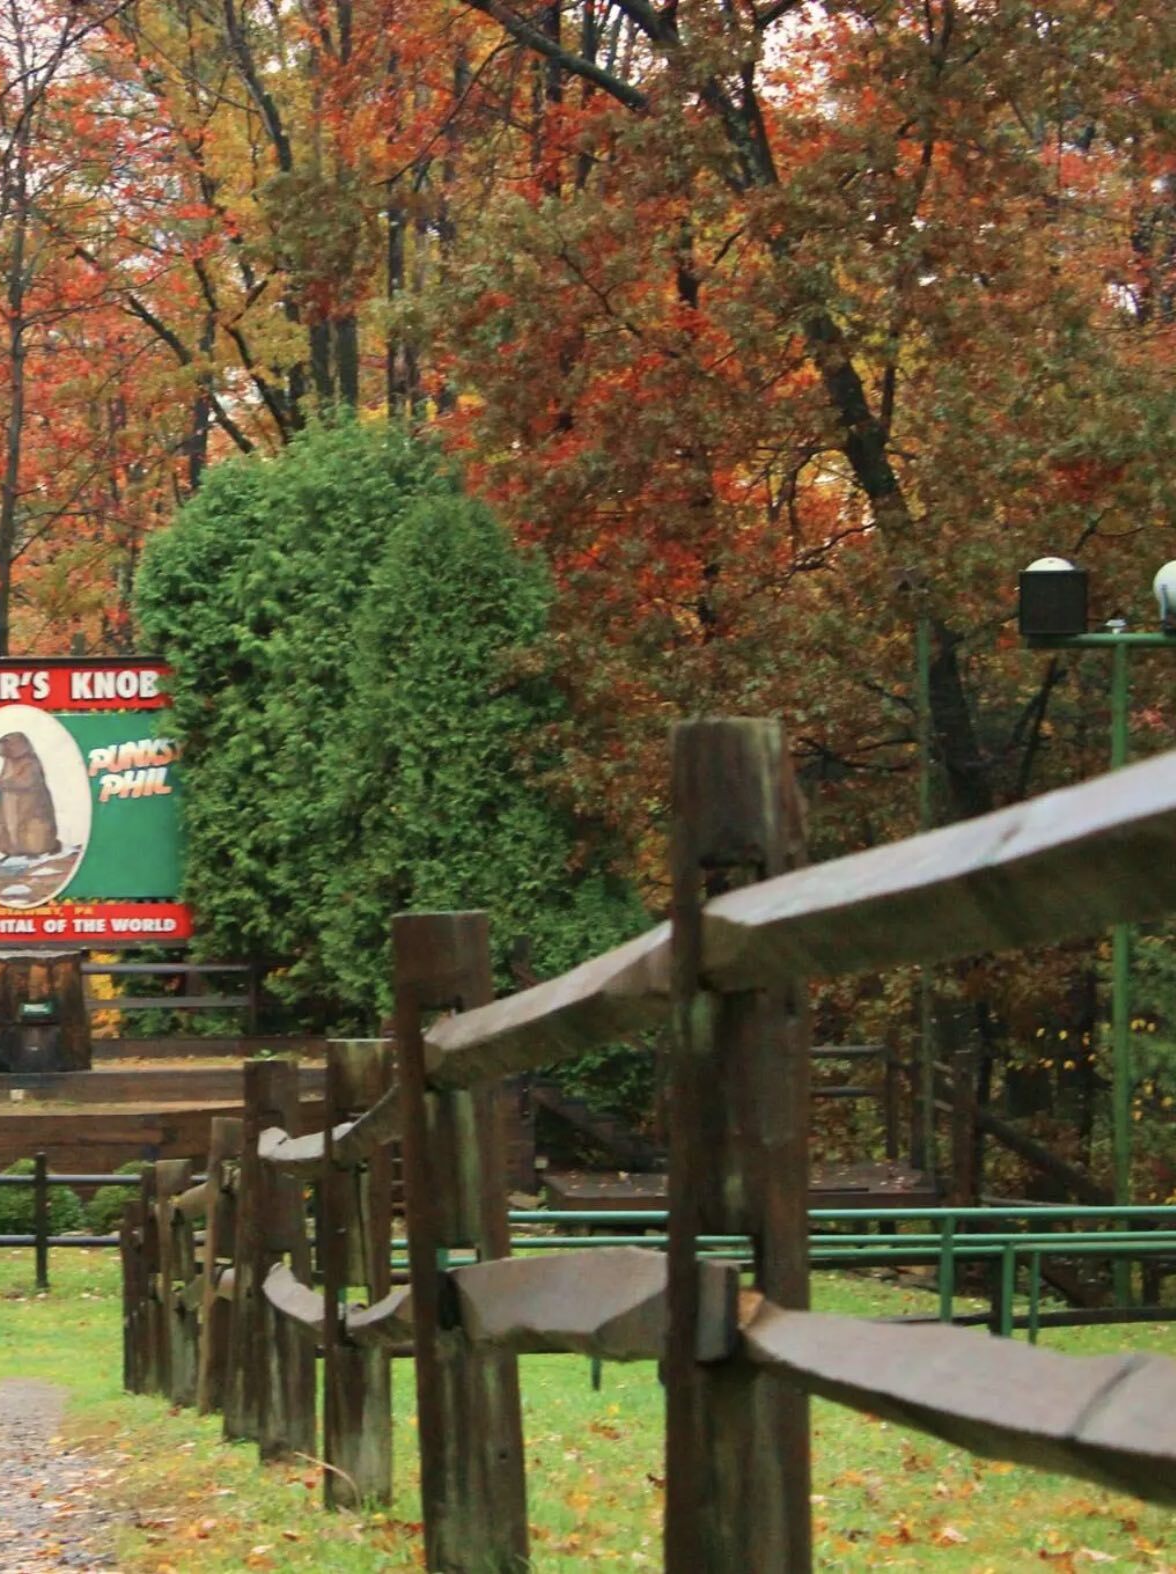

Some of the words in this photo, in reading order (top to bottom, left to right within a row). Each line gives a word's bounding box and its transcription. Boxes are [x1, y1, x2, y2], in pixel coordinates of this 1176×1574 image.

[70, 670, 160, 700] KNOB
[98, 766, 173, 803] PHIL
[42, 918, 68, 933] OF
[72, 918, 108, 933] THE
[110, 917, 177, 933] WORLD
